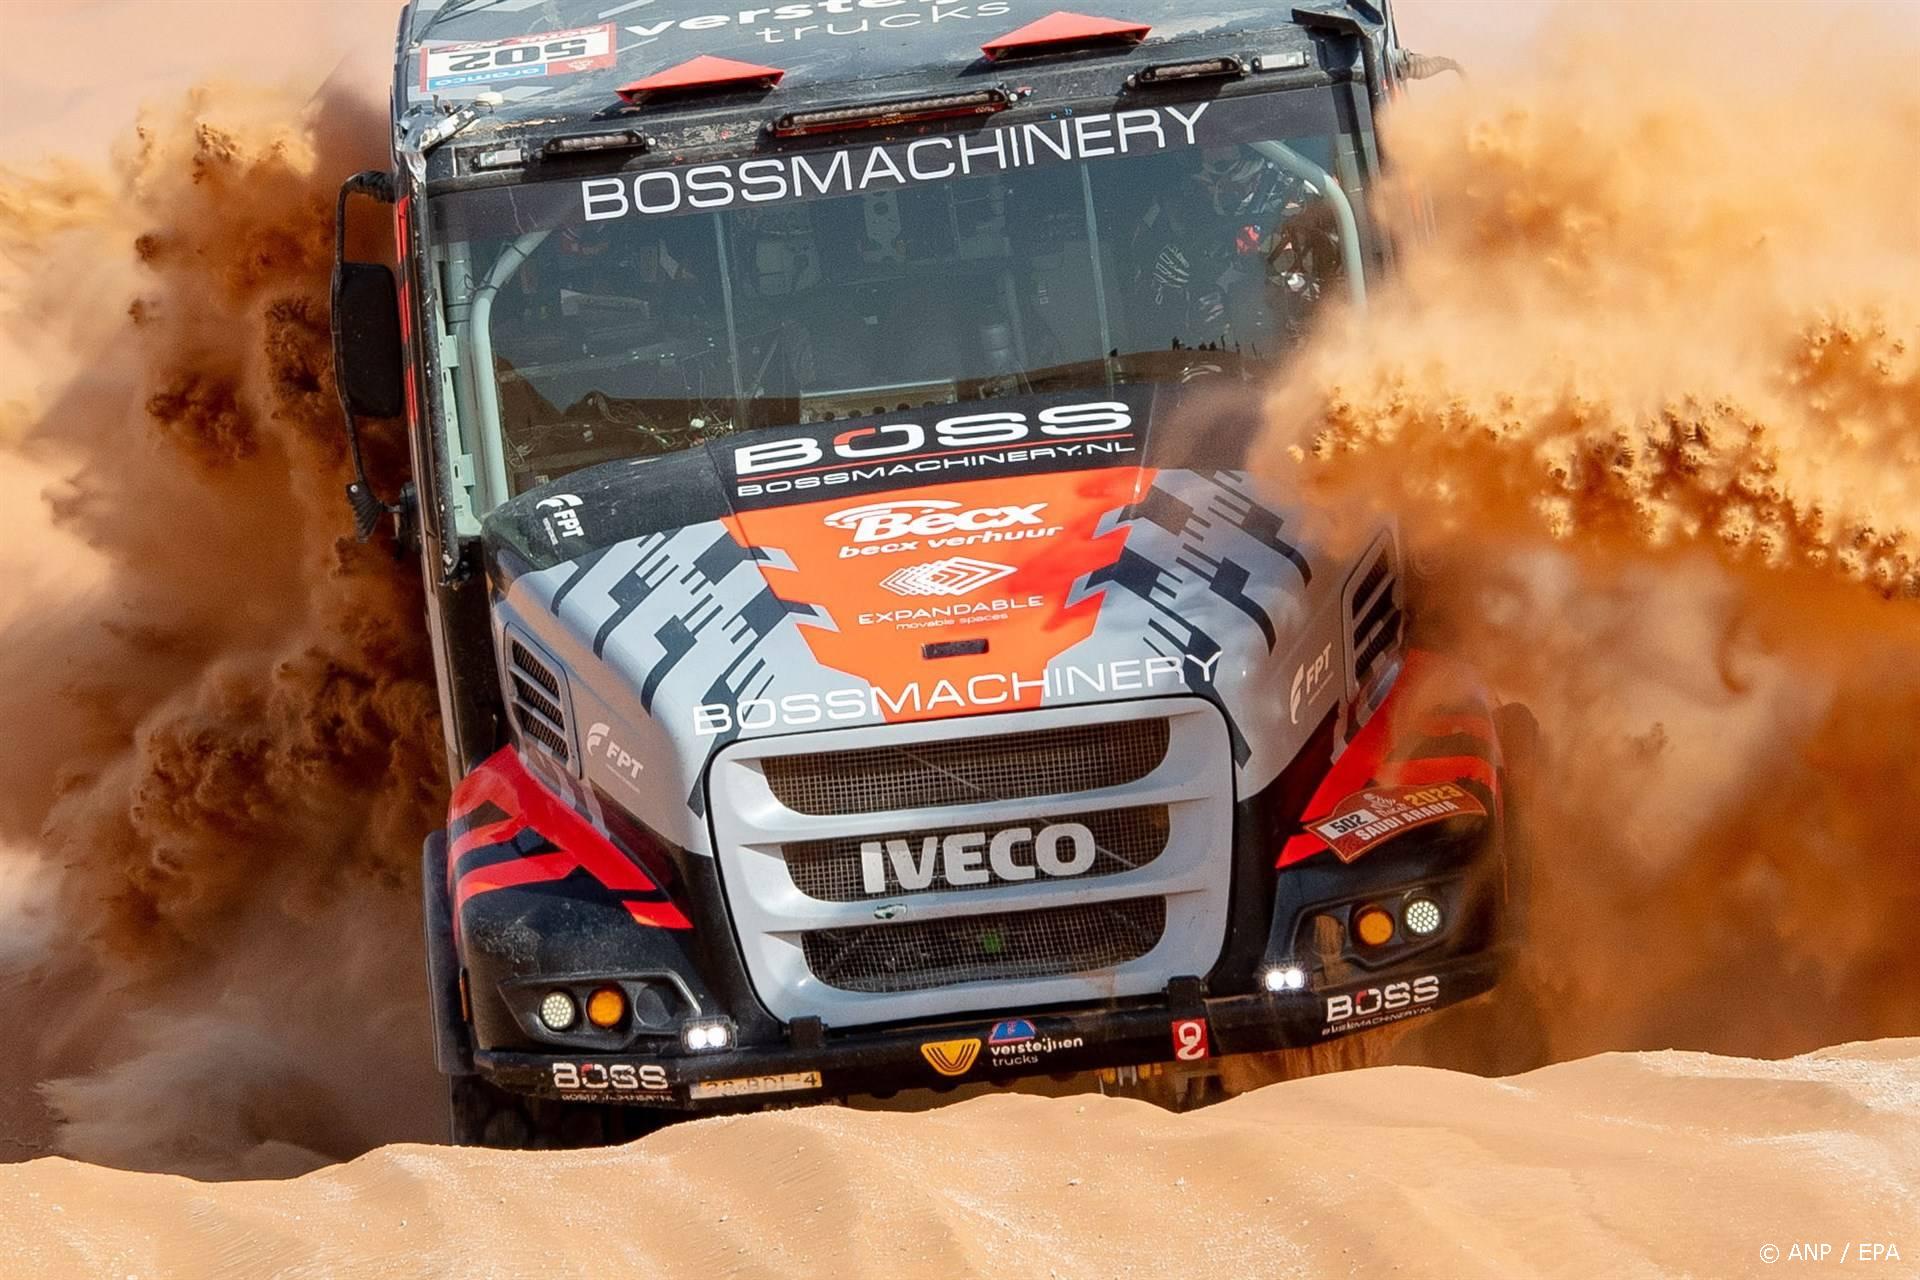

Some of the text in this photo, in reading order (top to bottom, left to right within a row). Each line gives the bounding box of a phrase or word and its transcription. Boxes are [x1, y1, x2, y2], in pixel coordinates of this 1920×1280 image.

[755, 1, 1011, 44] trucks
[449, 38, 588, 72] 502
[435, 67, 540, 87] aramco
[582, 101, 1211, 222] BOSSMACHINERY
[733, 401, 1132, 475] BOSS
[736, 441, 1136, 497] BOSSMACHINERY.NL
[553, 508, 585, 538] FPT
[853, 502, 1049, 543] Becx
[838, 526, 1064, 559] becx verhuur
[858, 595, 1044, 625] EXPANDABLE
[896, 612, 1009, 631] movable spaces
[1306, 641, 1333, 695] FPT
[692, 650, 1224, 737] BOSSMACHINERY
[605, 740, 645, 779] FPT
[1404, 785, 1464, 807] 2023
[1330, 813, 1369, 834] 502
[1354, 800, 1460, 841] SAUDI ARABIA
[860, 822, 1097, 895] IVECO
[1326, 975, 1440, 1022] BOSS
[553, 1062, 669, 1090] BOSS
[992, 1053, 1039, 1068] trucks
